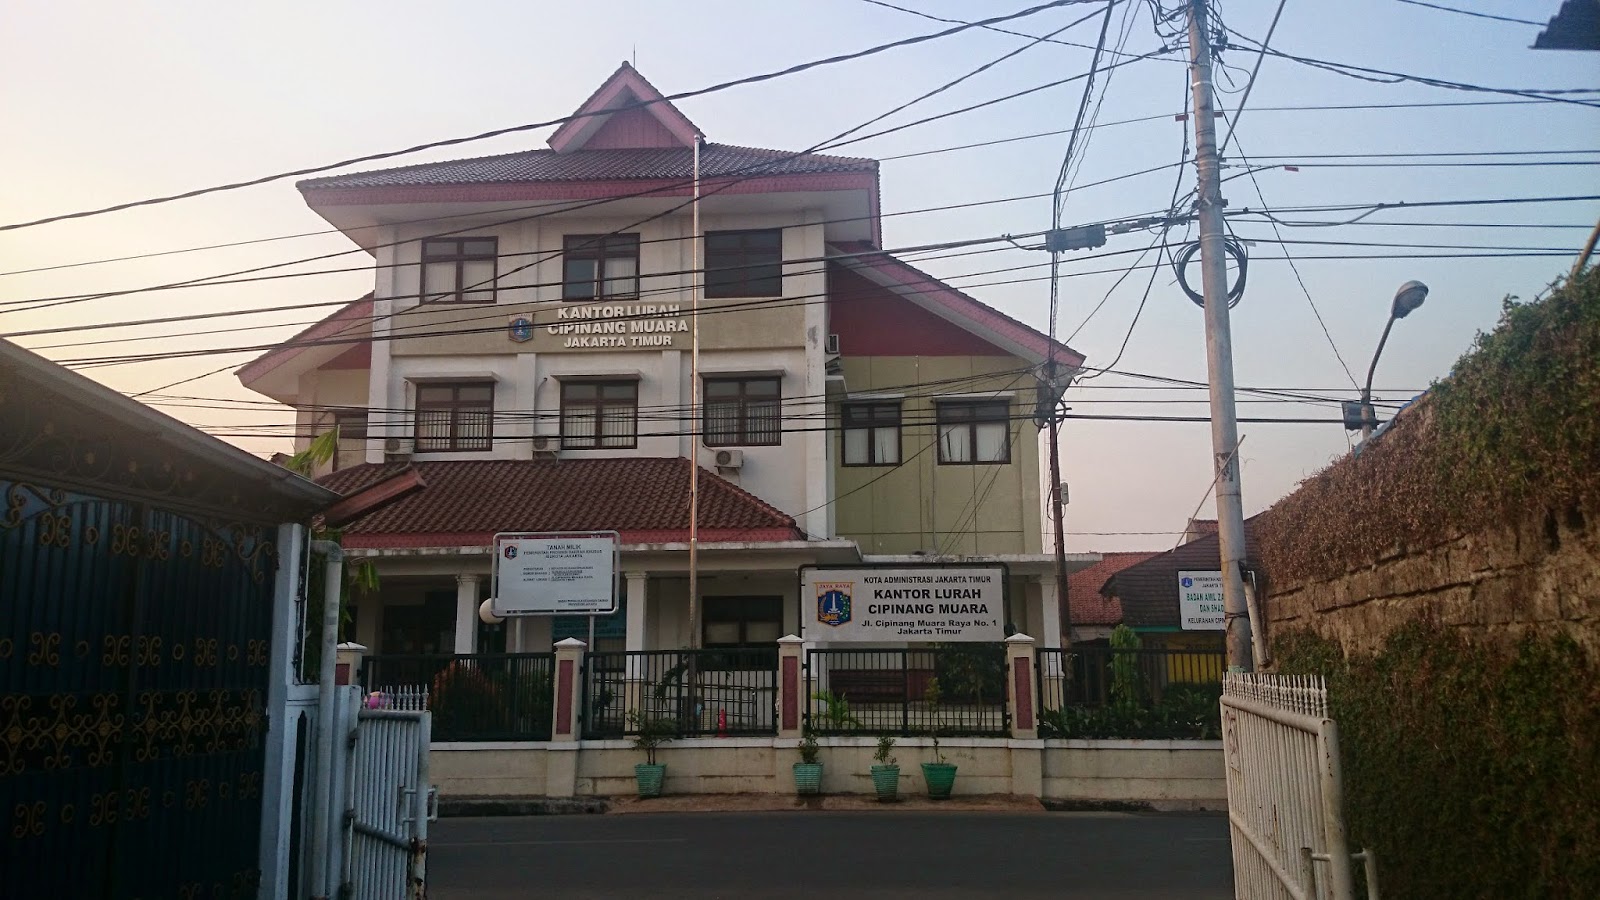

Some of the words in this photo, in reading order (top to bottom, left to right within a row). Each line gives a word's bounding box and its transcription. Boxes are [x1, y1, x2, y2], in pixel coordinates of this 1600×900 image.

[557, 306, 625, 319] KANTOR
[626, 304, 680, 318] LURAH
[547, 321, 626, 335] CIPINANG
[630, 319, 689, 333] MUARA
[564, 336, 627, 348] JAKARTA
[630, 335, 673, 347] TIMUR
[863, 576, 882, 584] KOTA
[884, 576, 933, 584] ADMINISTRASI
[968, 575, 991, 583] TIMUR
[873, 589, 931, 600] KANTOR
[934, 588, 981, 599] LURAH
[1186, 593, 1203, 601] BADAN
[1205, 593, 1216, 601] AMIL
[868, 604, 935, 615] CIPINANG
[938, 603, 989, 614] MUARA
[1199, 604, 1210, 612] DAN
[1211, 604, 1224, 612] SHAD
[875, 619, 915, 628] Cipinang
[917, 619, 946, 627] Muara
[948, 619, 971, 628] Raya
[974, 619, 989, 627] No.
[992, 619, 997, 627] 1
[897, 627, 933, 635] Jakarta
[934, 627, 962, 635] Timur
